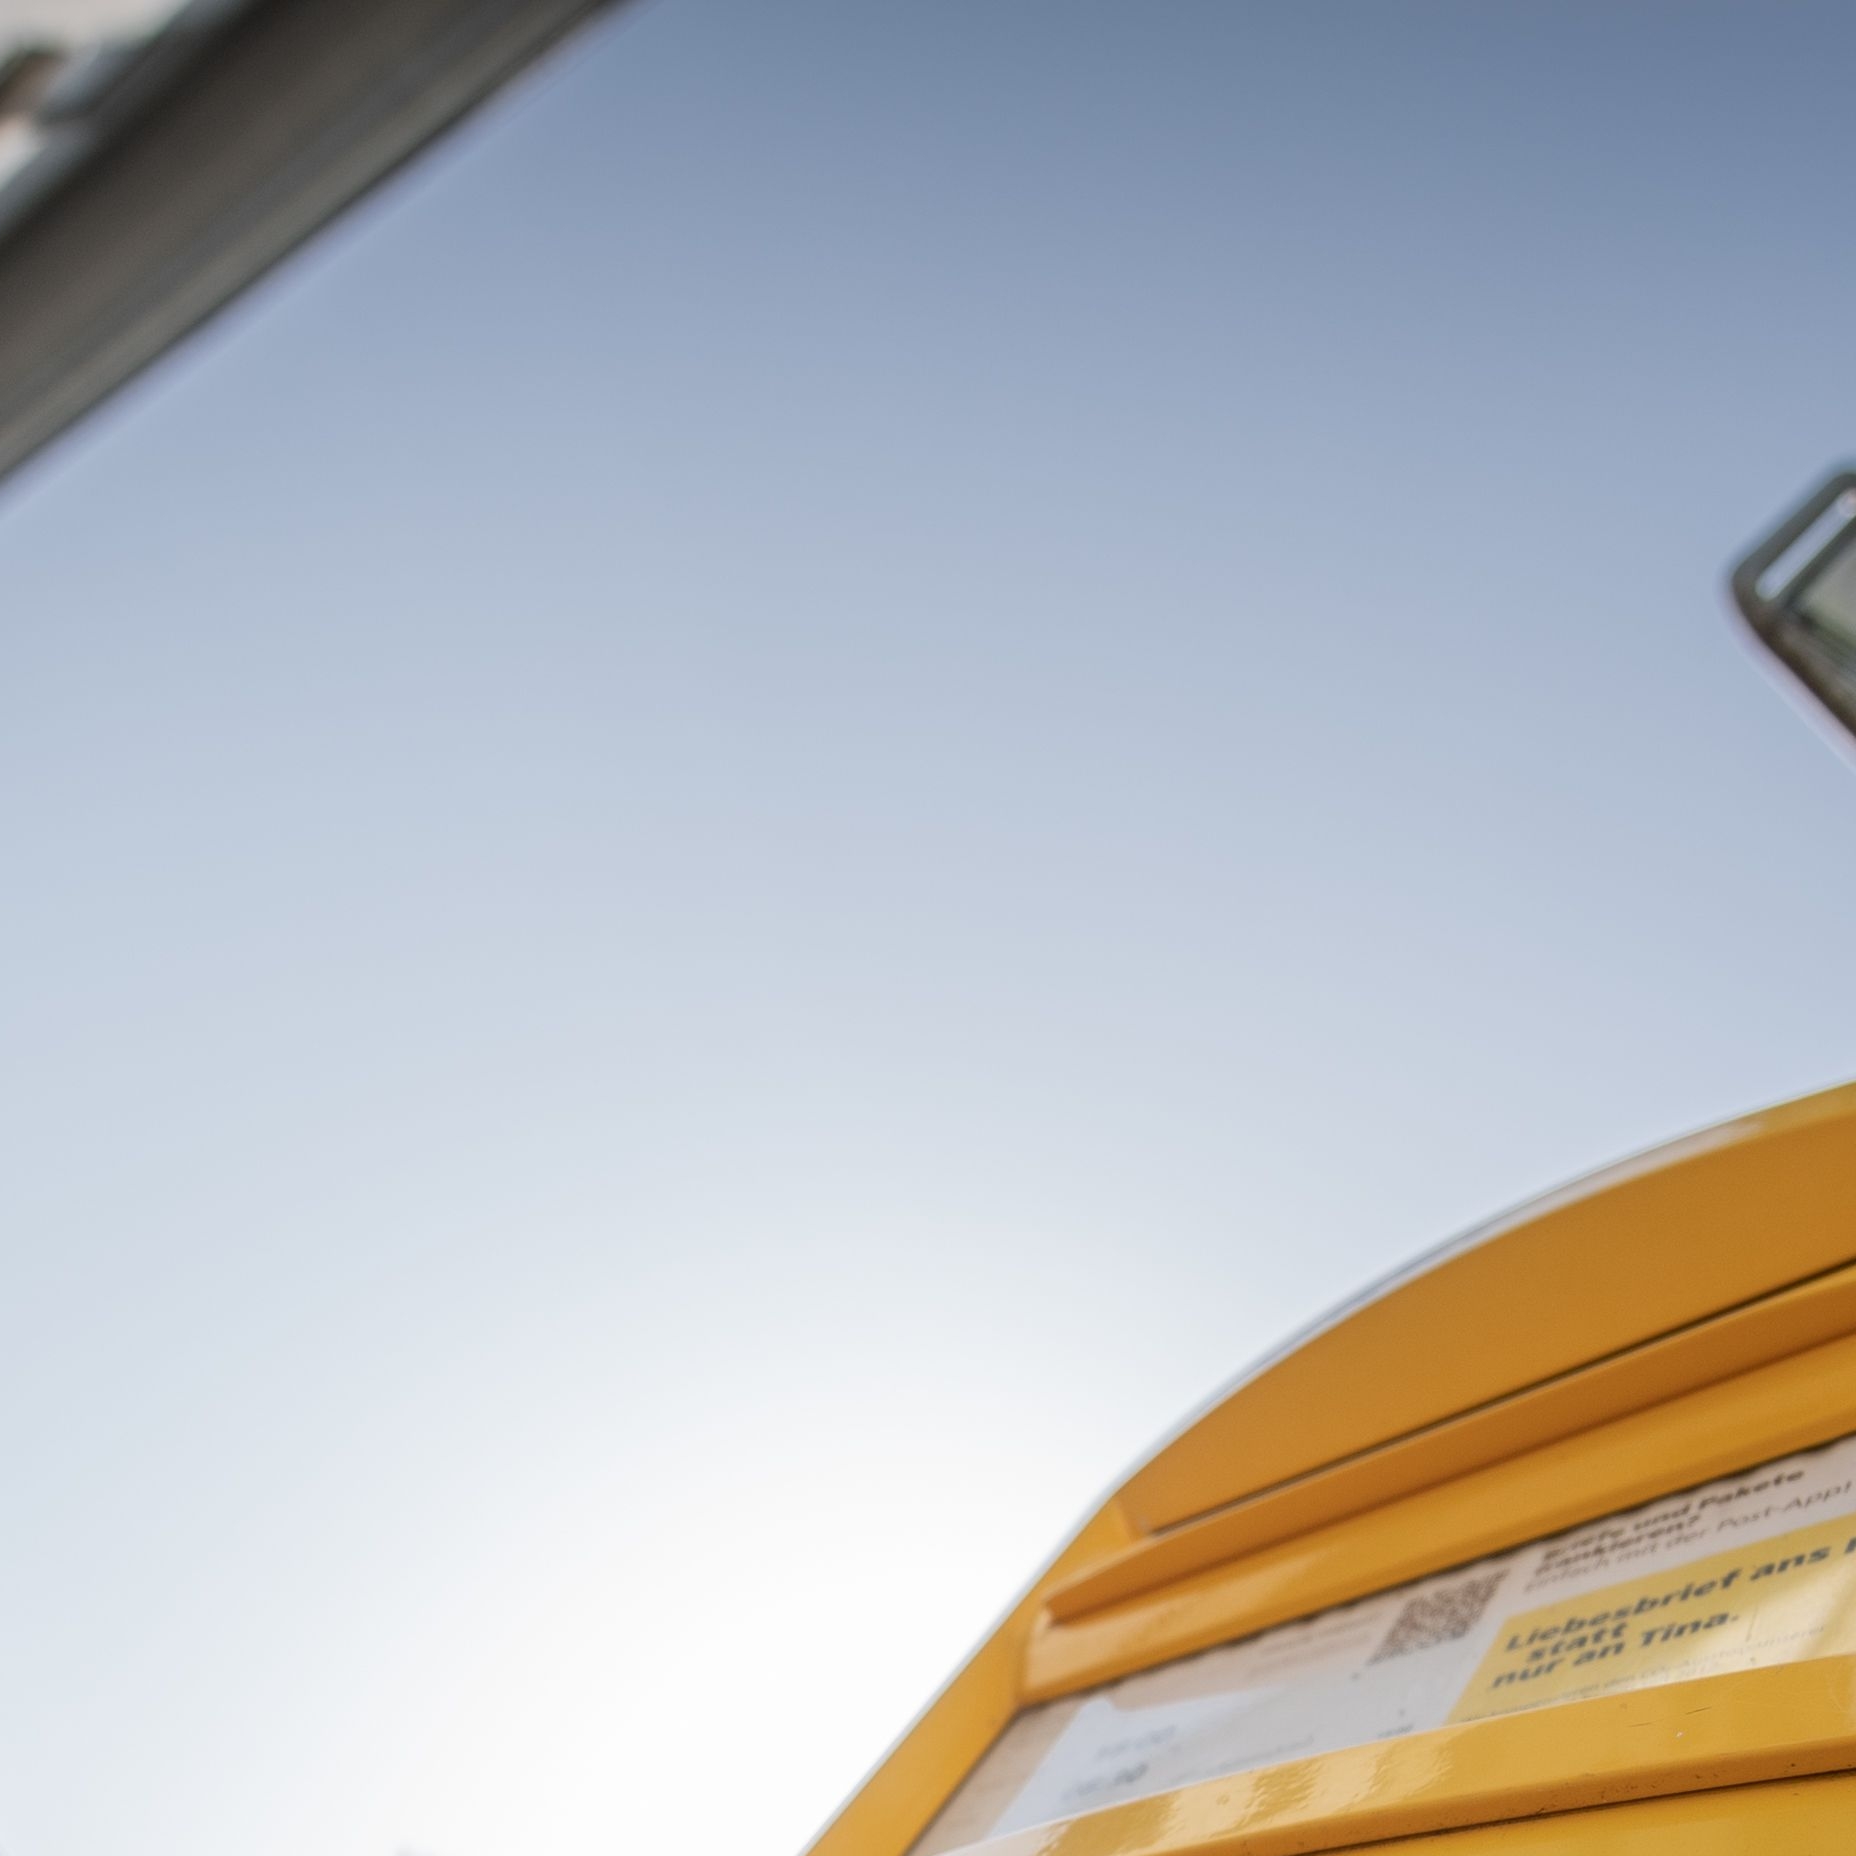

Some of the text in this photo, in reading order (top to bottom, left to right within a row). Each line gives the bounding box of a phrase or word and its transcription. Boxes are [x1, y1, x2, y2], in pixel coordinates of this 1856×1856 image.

[1633, 1502, 1691, 1531] und
[1698, 1470, 1805, 1510] Pakete
[1716, 1479, 1853, 1533] Post-App!
[1505, 1568, 1743, 1651] Liebesbrief
[1749, 1546, 1833, 1582] ans
[1490, 1612, 1741, 1689] nur an Tina.
[1527, 1621, 1628, 1662] statt
